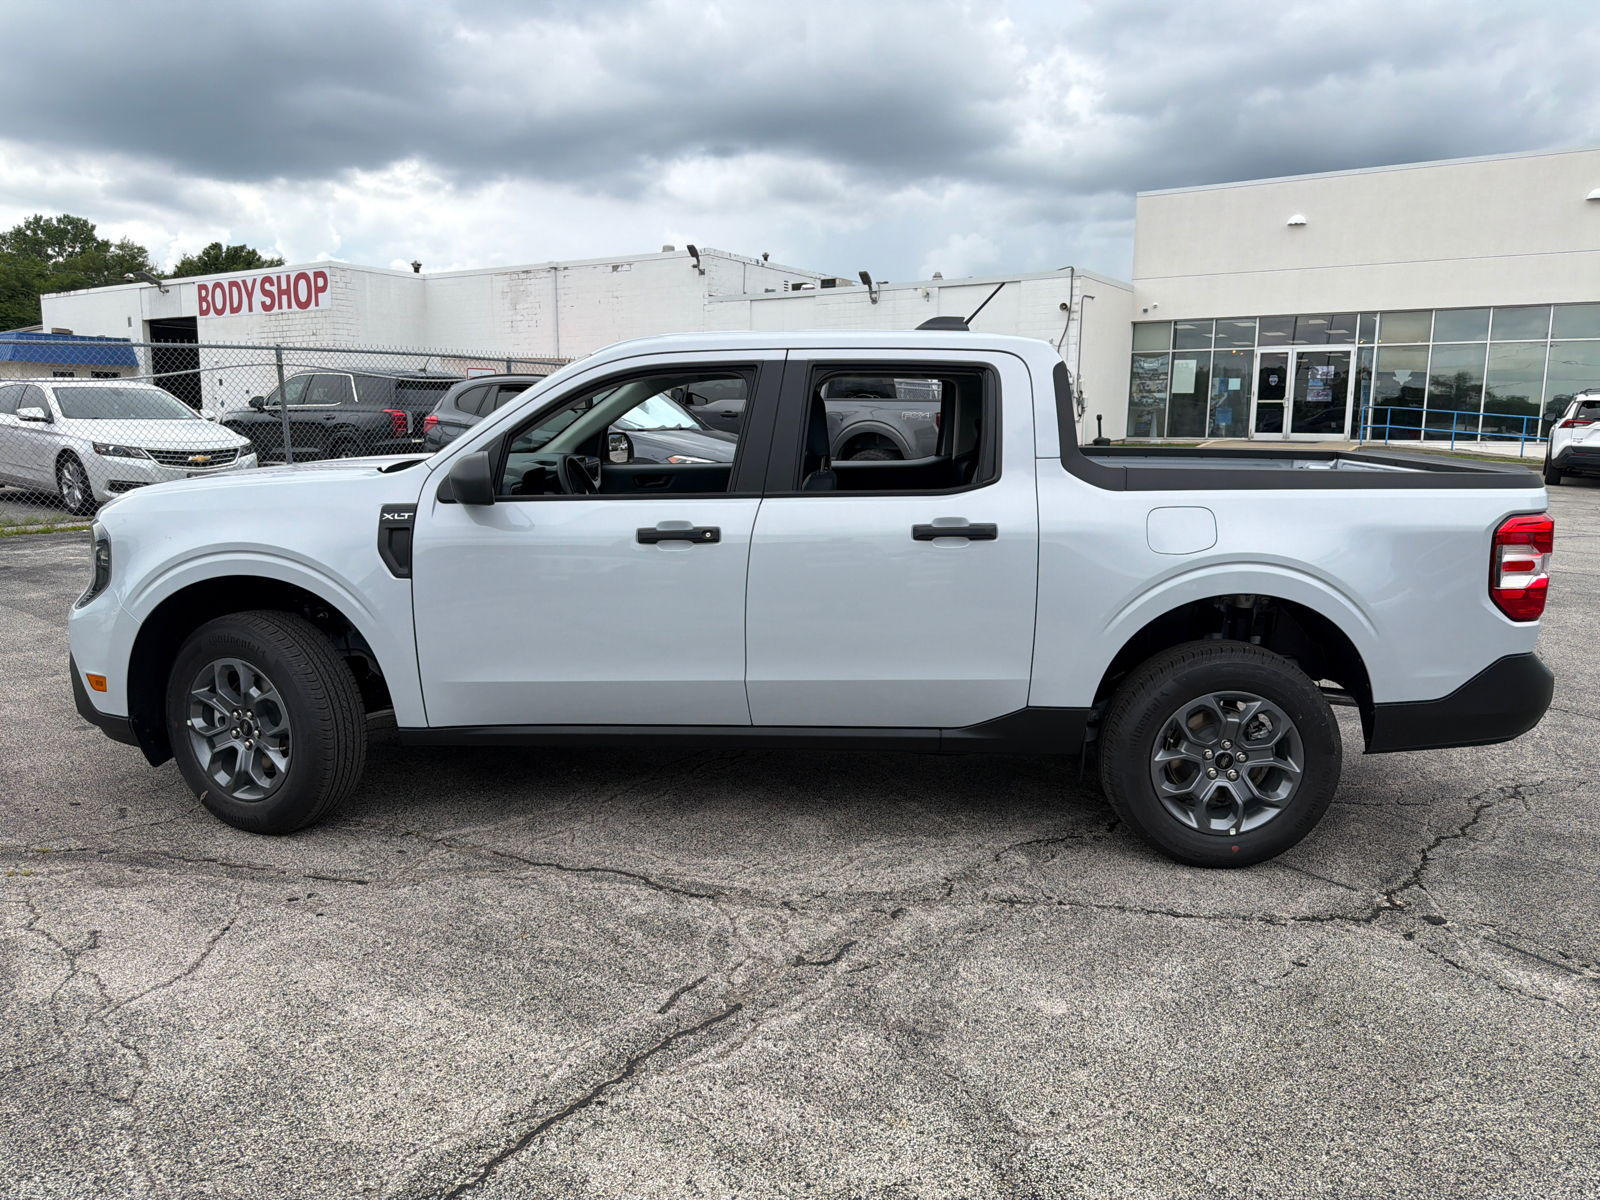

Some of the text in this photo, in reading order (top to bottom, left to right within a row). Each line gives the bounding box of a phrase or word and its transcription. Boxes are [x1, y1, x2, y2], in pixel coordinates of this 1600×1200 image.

[901, 411, 930, 420] FX4
[382, 512, 414, 520] XLT
[209, 632, 261, 655] Continental
